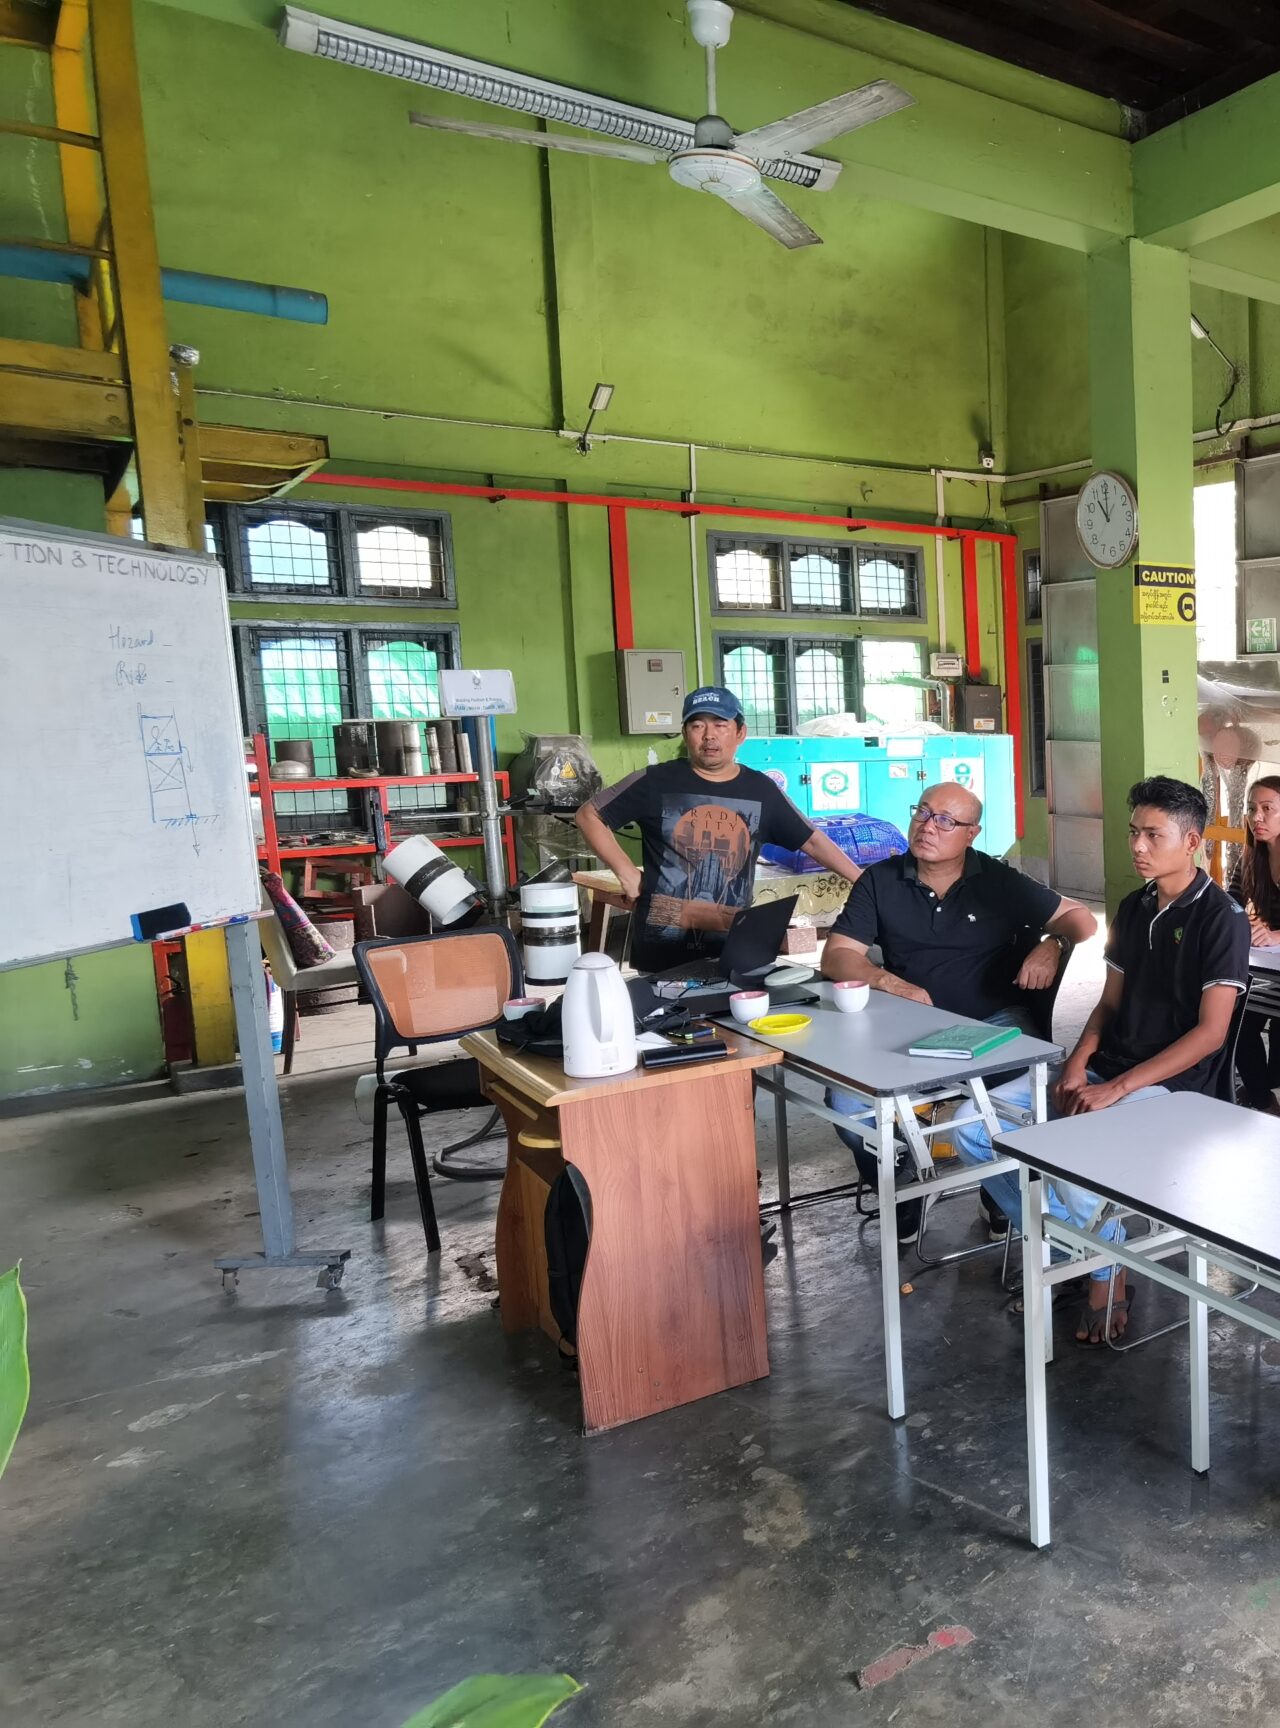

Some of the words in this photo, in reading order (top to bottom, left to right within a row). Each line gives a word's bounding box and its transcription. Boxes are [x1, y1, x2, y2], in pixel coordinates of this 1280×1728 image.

[0, 542, 62, 566] TION
[71, 550, 86, 568] &
[92, 552, 209, 585] TECHNOLOGY
[1142, 570, 1194, 585] CAUTION
[690, 820, 736, 832] CITY
